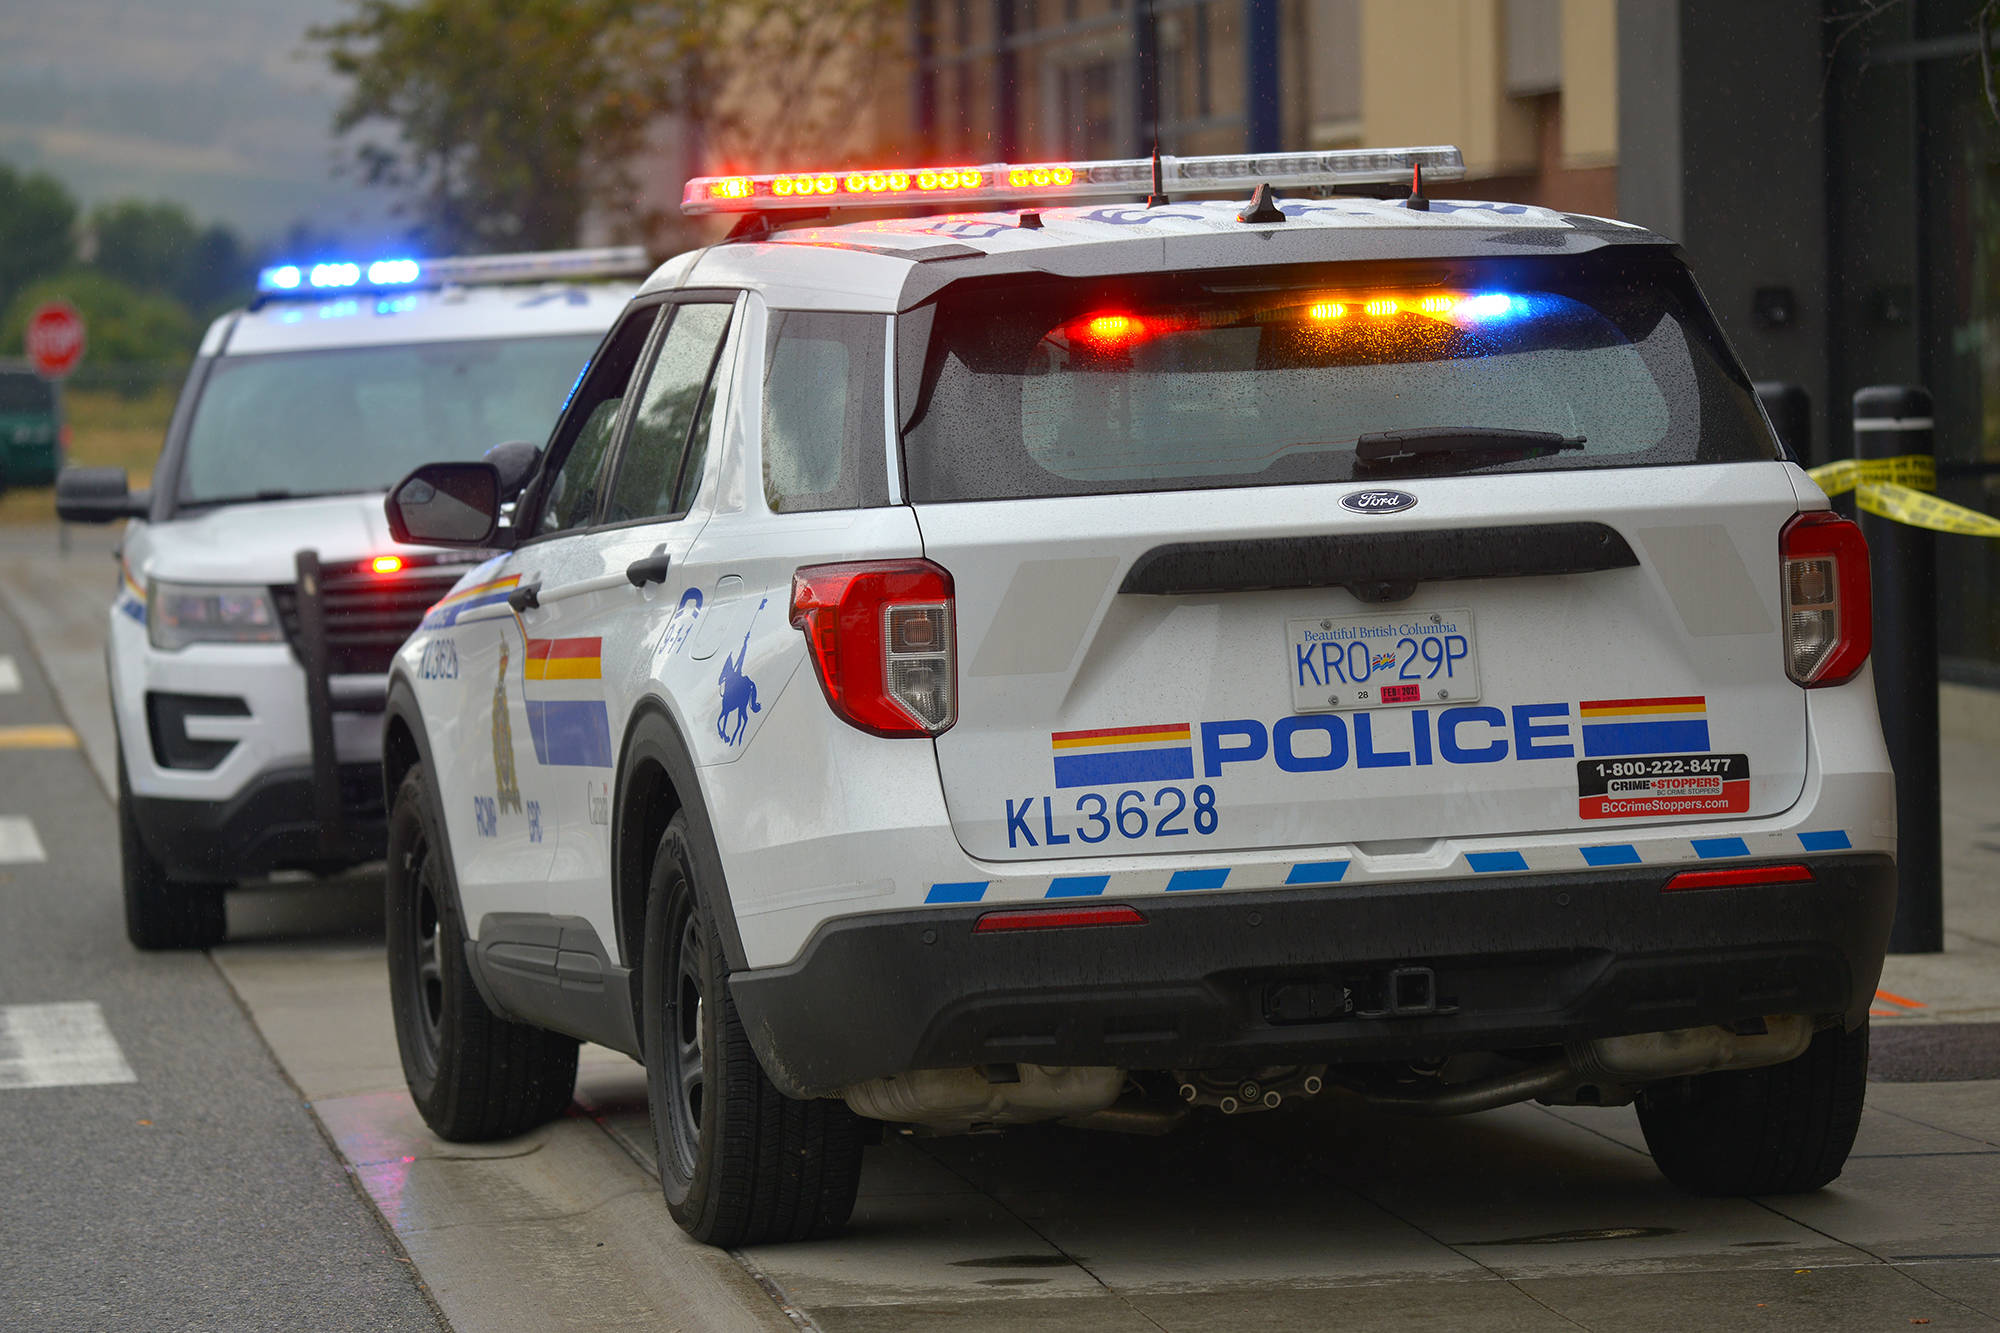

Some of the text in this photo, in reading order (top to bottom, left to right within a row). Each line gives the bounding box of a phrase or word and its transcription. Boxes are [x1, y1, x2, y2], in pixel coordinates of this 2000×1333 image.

[1357, 492, 1400, 508] Ford
[1303, 621, 1457, 642] Beautiful British Columbia
[1396, 634, 1468, 681] 29P
[1358, 691, 1369, 699] 28
[1200, 702, 1575, 778] POLICE
[1595, 758, 1732, 777] 1-800-222-8477
[1611, 776, 1720, 792] CRIME STOPPERS
[1656, 786, 1720, 796] BC CRIME STOPPERS
[1601, 799, 1729, 814] BCCrimeStoppers.com
[1005, 784, 1219, 849] KL3628
